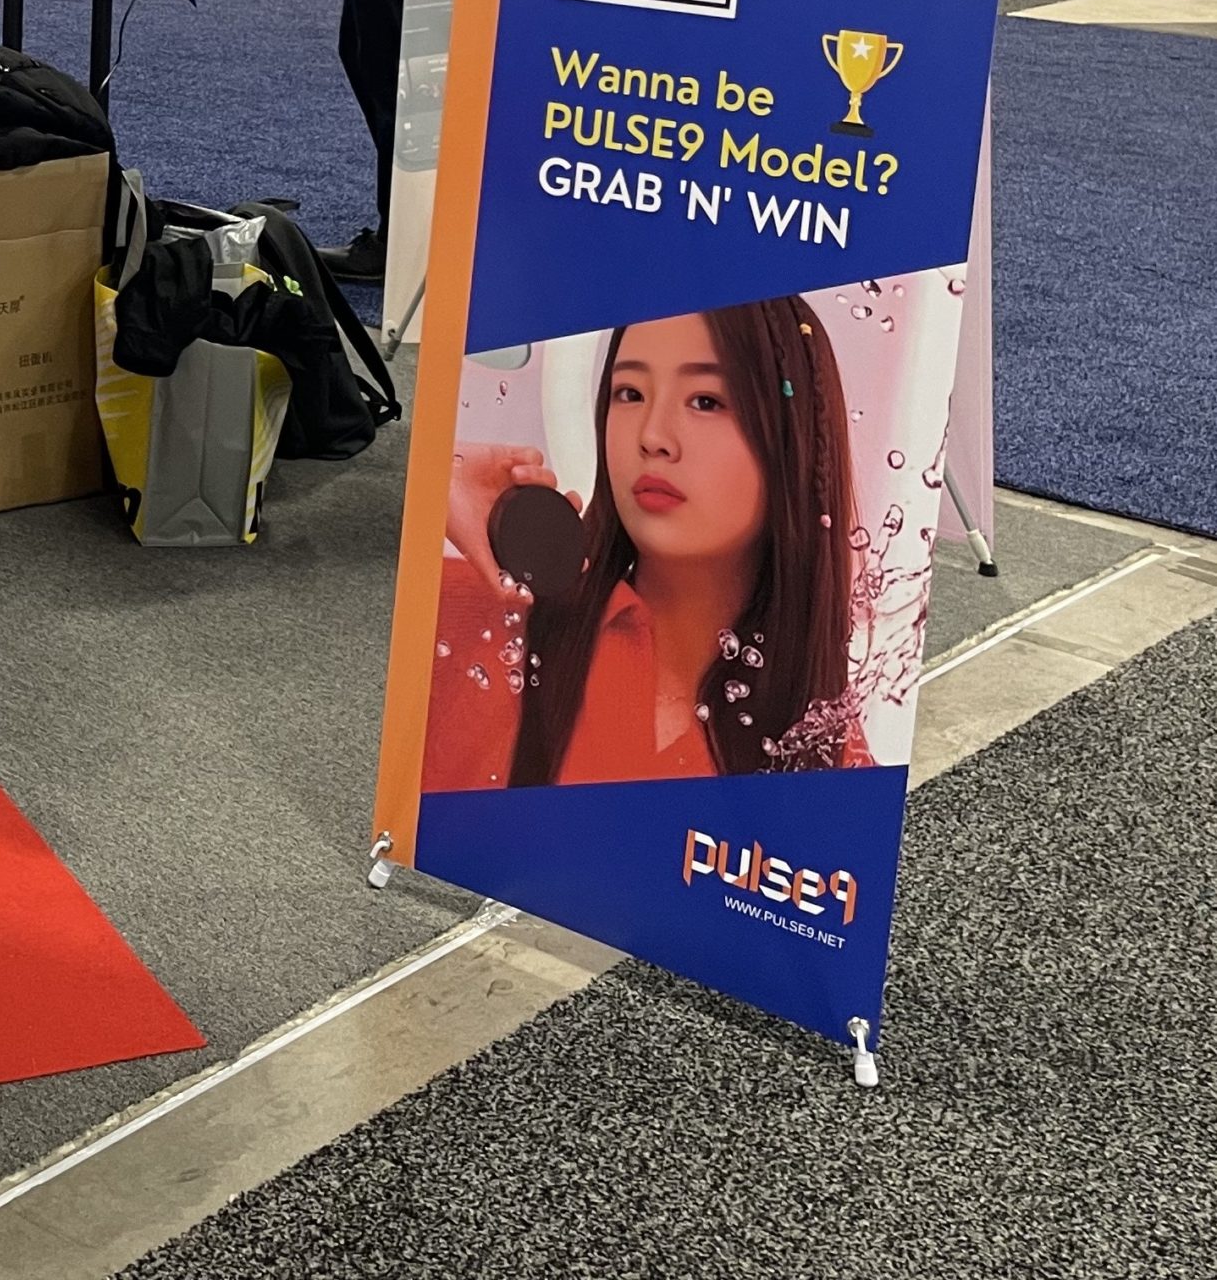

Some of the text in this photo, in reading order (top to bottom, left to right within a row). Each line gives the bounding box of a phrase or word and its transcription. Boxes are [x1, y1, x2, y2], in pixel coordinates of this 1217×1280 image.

[551, 47, 775, 116] Wanna be
[544, 101, 899, 196] PULSE9 Model?
[538, 157, 850, 249] GRAB 'N' WIN
[683, 828, 857, 926] pulse9
[724, 895, 846, 950] WWW.PULSE9.NET
